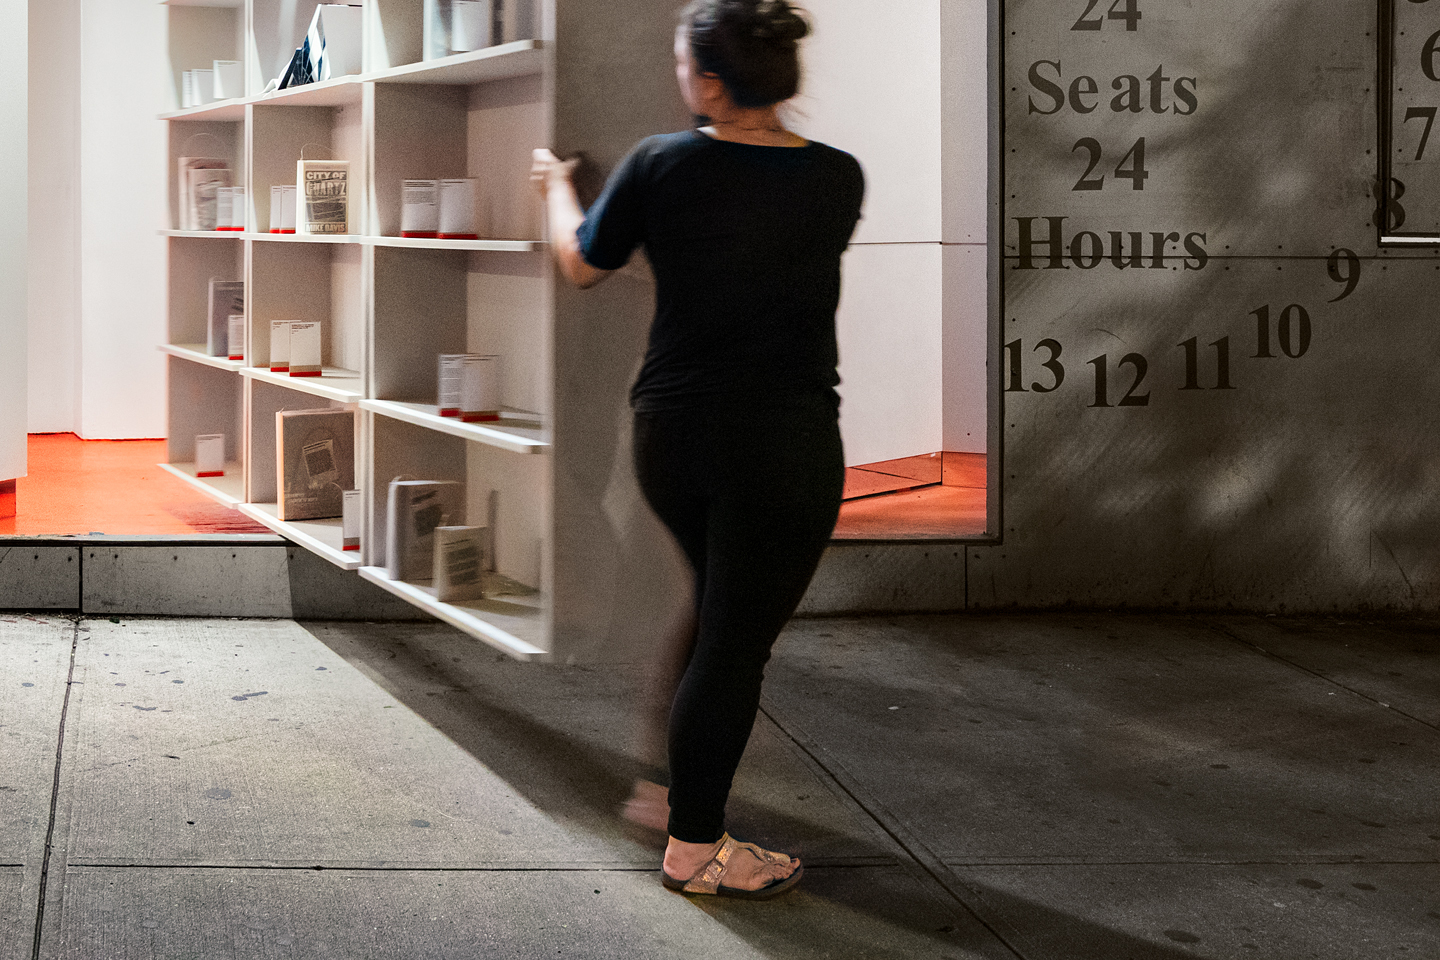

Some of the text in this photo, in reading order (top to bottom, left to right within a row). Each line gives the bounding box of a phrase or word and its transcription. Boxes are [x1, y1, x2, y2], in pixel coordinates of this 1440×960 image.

[1027, 59, 1199, 116] Seats
[1403, 106, 1438, 161] 7
[306, 171, 346, 180] CITY OF
[1071, 136, 1149, 192] 24
[1010, 215, 1209, 271] Hours
[1326, 248, 1361, 303] 9
[1248, 303, 1312, 359] 10
[1003, 338, 1066, 393] 13
[1086, 352, 1151, 408] 12
[1176, 335, 1237, 391] 11
